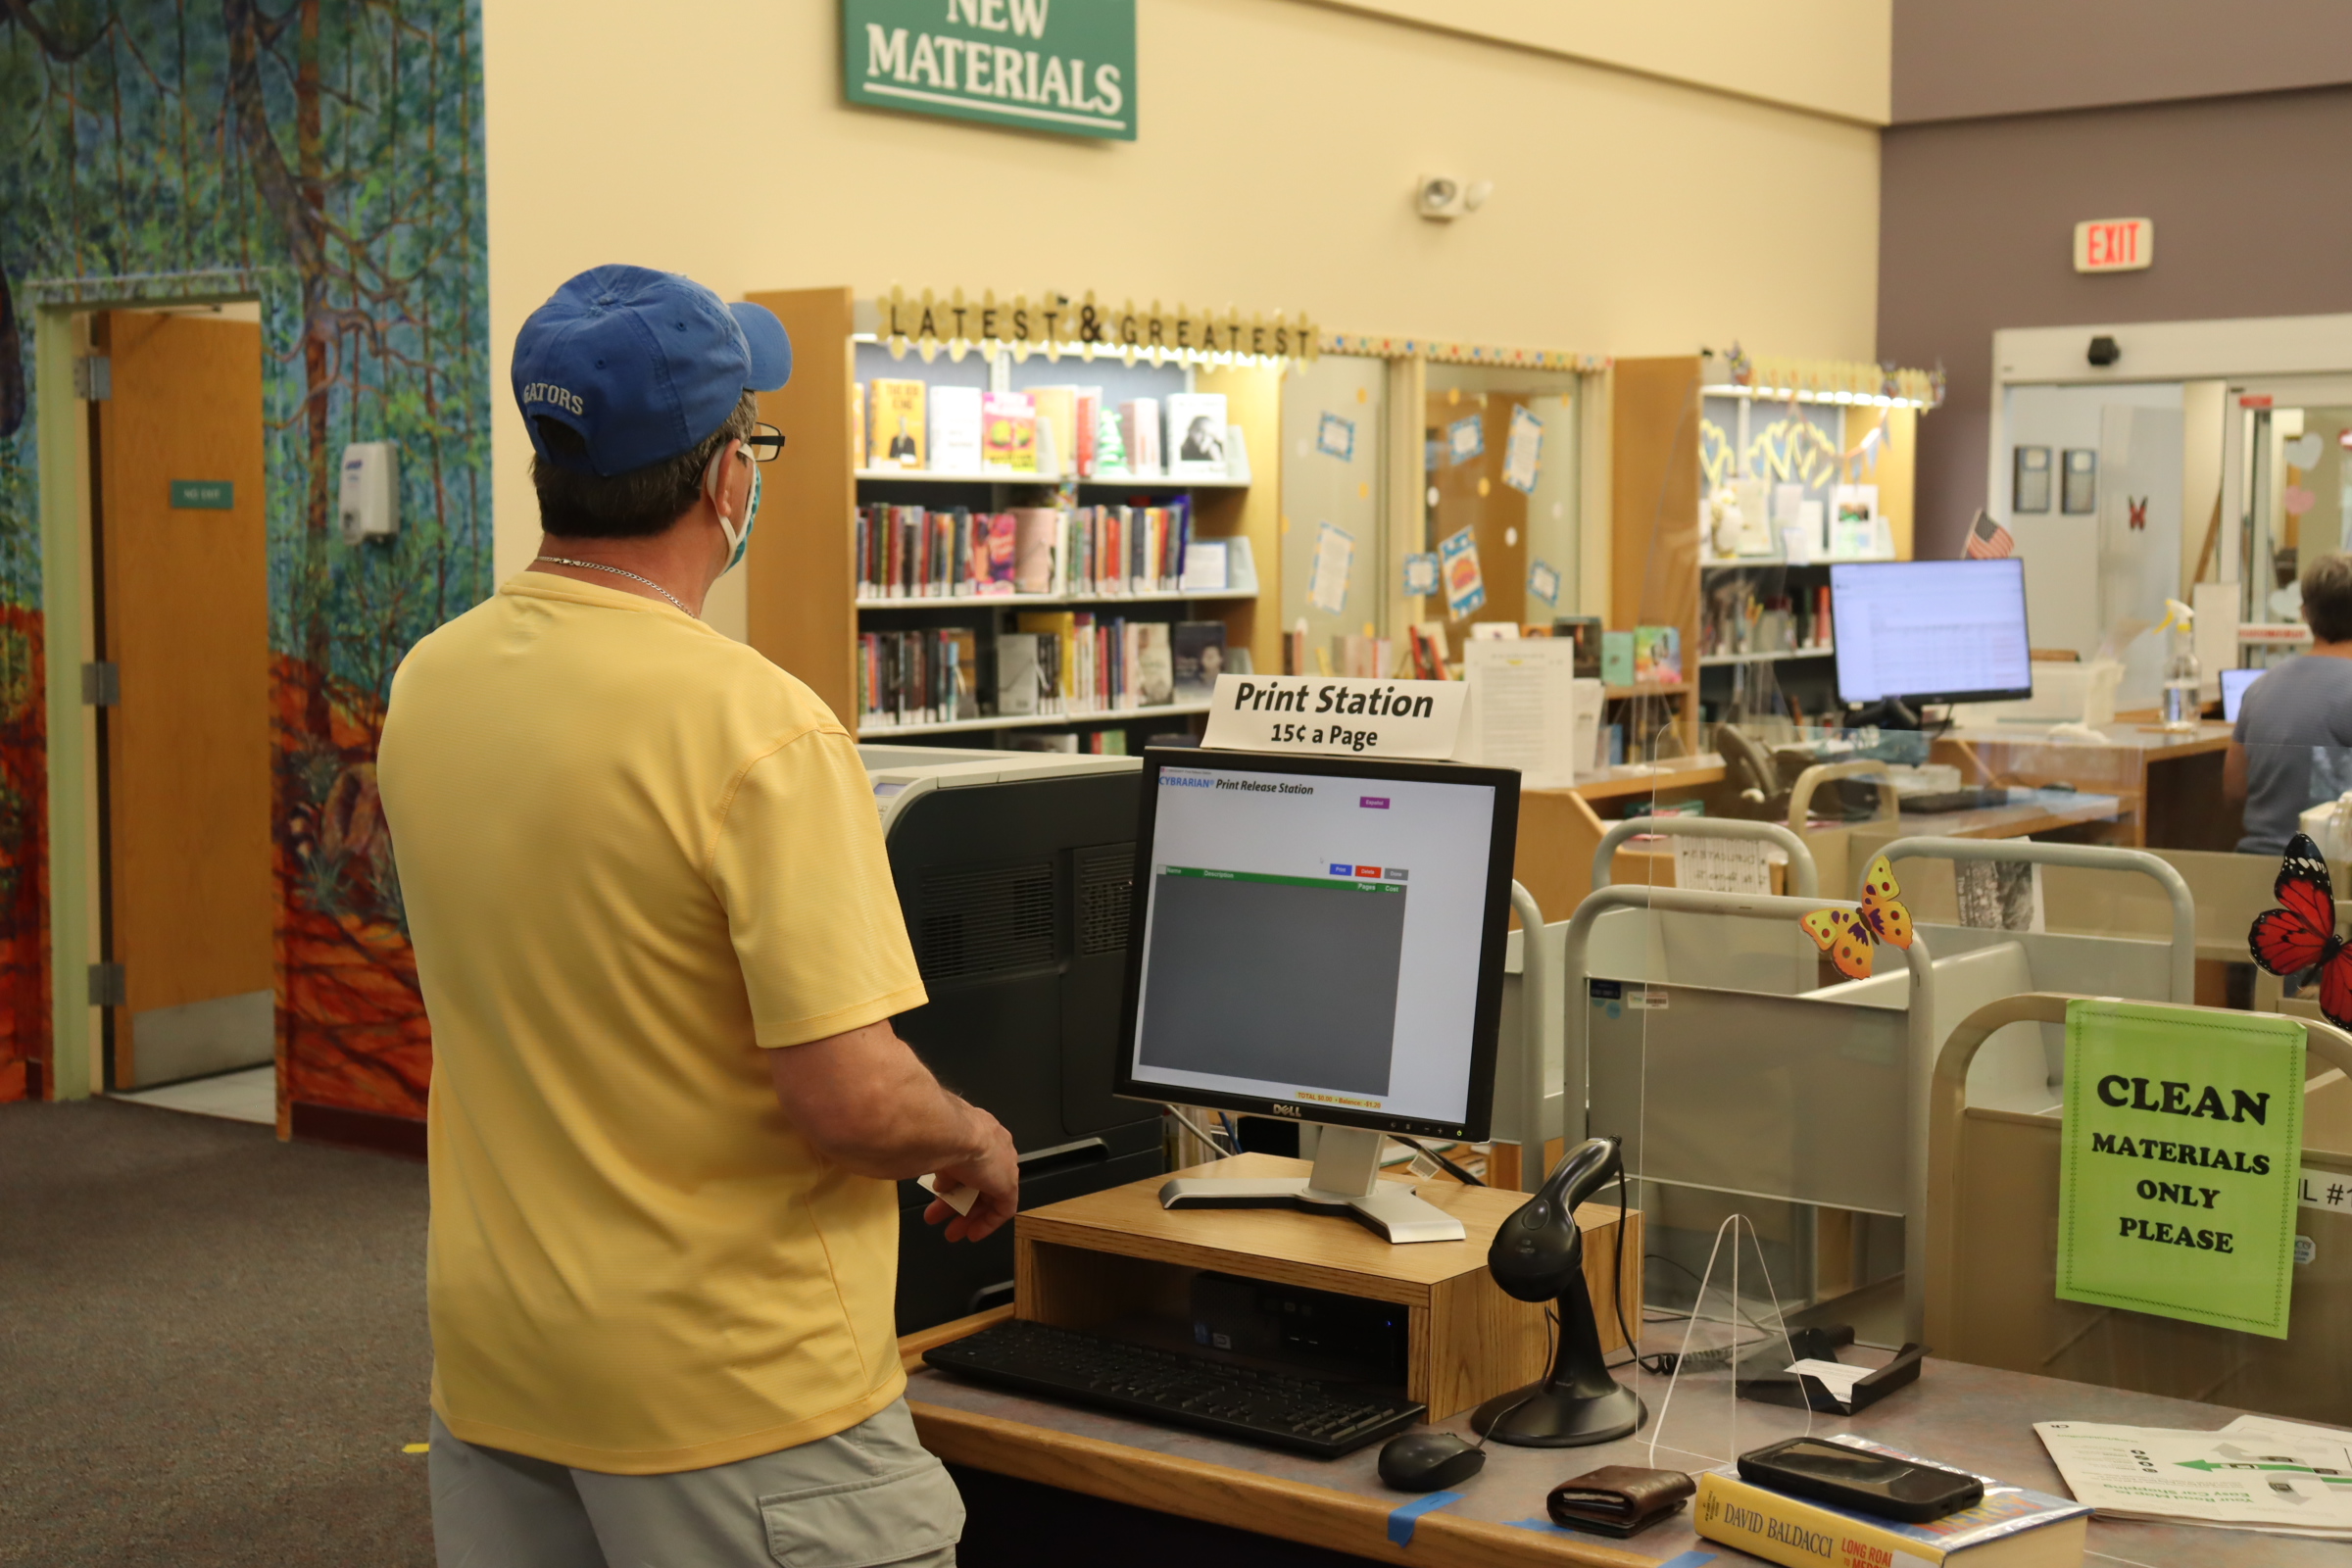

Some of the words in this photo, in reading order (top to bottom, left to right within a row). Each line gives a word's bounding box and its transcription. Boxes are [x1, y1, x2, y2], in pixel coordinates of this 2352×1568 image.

[865, 23, 1123, 116] MATERIALS
[2087, 220, 2141, 267] EXIT
[890, 307, 1059, 342] LATEST
[1079, 305, 1103, 344] &
[1120, 316, 1311, 357] GREATEST
[523, 382, 584, 416] GATORS
[1235, 681, 1309, 713] Print
[1315, 685, 1434, 718] Station
[1271, 723, 1306, 744] 15¢
[1311, 728, 1323, 744] a
[1329, 725, 1378, 752] Page
[1215, 779, 1239, 791] Print
[1241, 780, 1277, 793] Release
[1278, 782, 1314, 796] Station
[1203, 869, 1235, 879] Description
[1273, 1103, 1301, 1117] DELL
[1298, 1092, 1316, 1101] TOTAL
[2097, 1074, 2270, 1126] CLEAN
[2091, 1132, 2270, 1175] MATERIALS
[2136, 1179, 2221, 1209] ONLY
[2119, 1216, 2234, 1254] PLEASE
[1724, 1503, 1763, 1534] DAVID
[1767, 1517, 1834, 1558] BALDACCI
[1841, 1538, 1867, 1558] LONG
